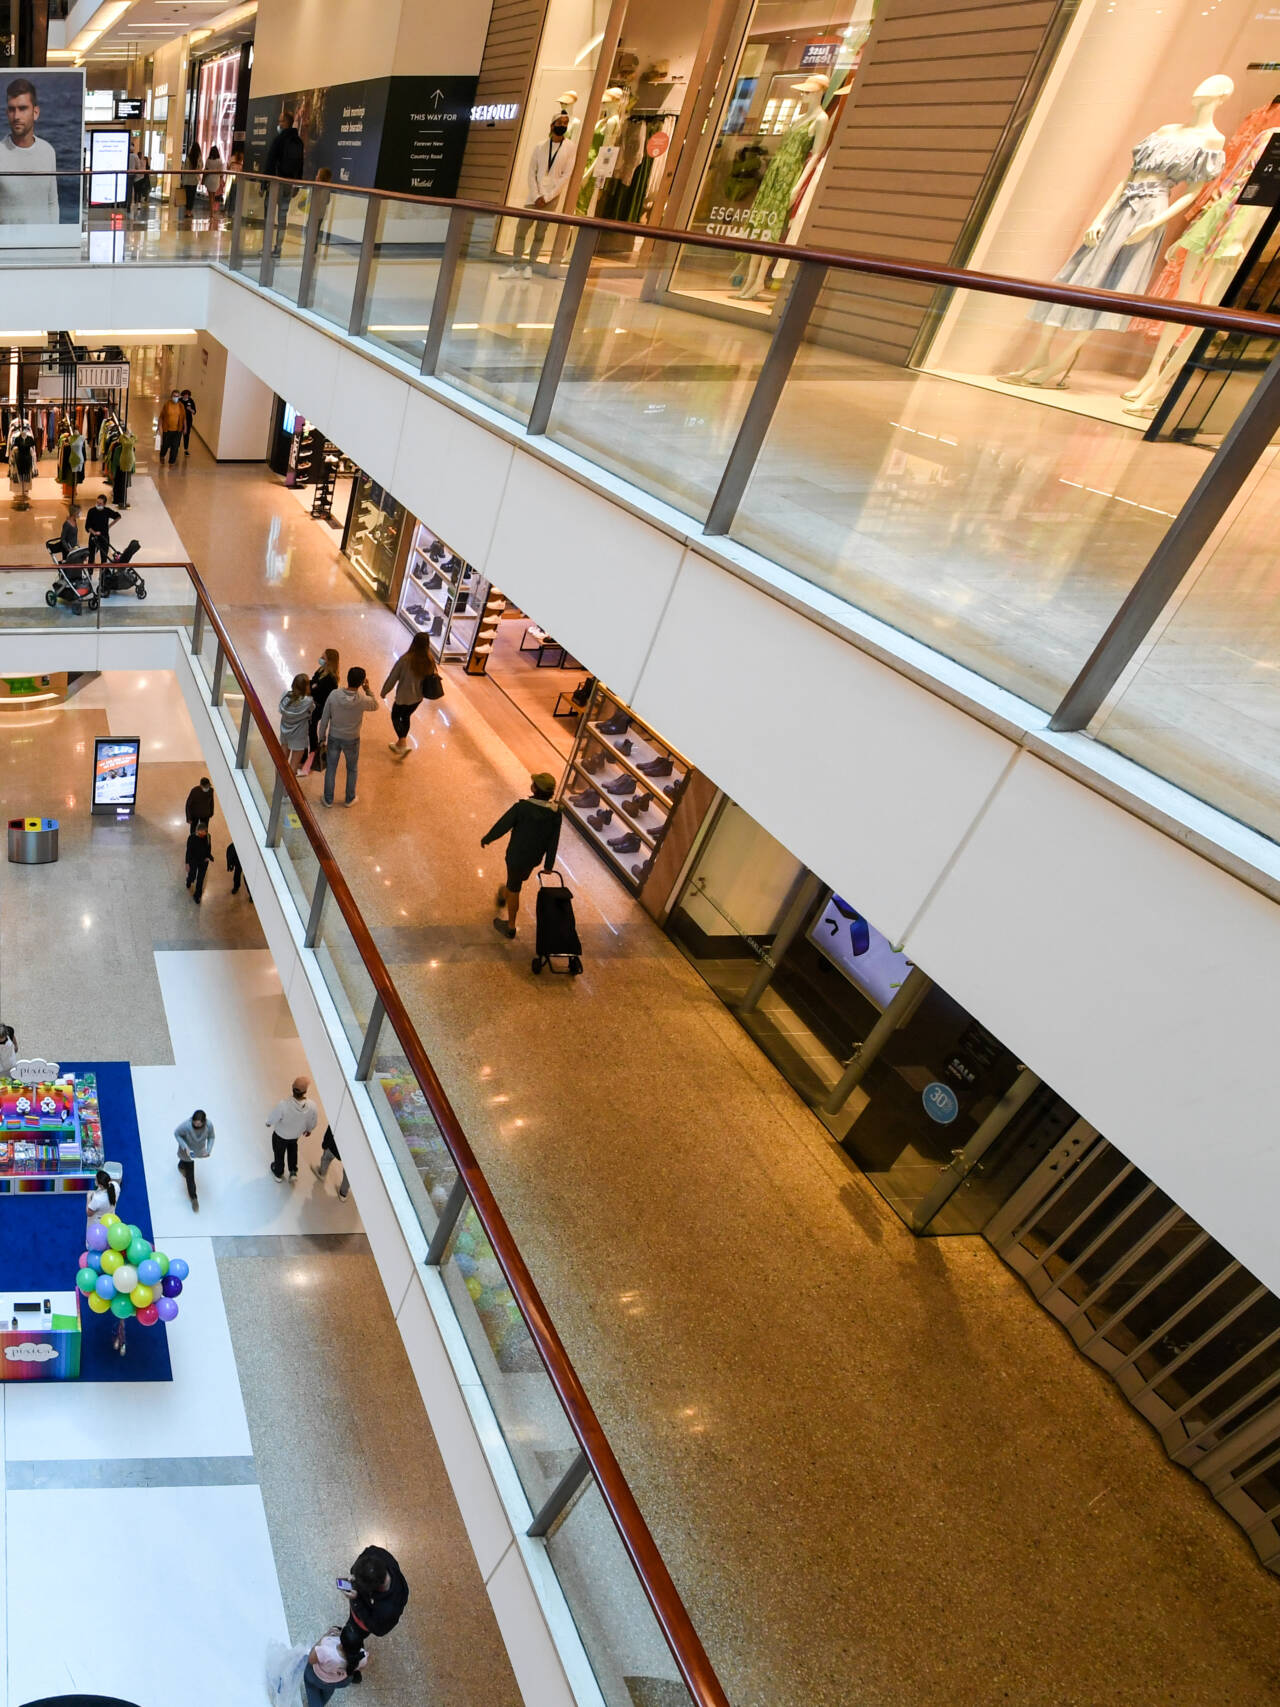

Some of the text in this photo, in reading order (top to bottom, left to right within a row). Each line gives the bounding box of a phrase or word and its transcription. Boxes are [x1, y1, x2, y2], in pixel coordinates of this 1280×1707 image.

[410, 113, 457, 121] THIS WAY FOR
[710, 206, 777, 224] ESCAPE TO
